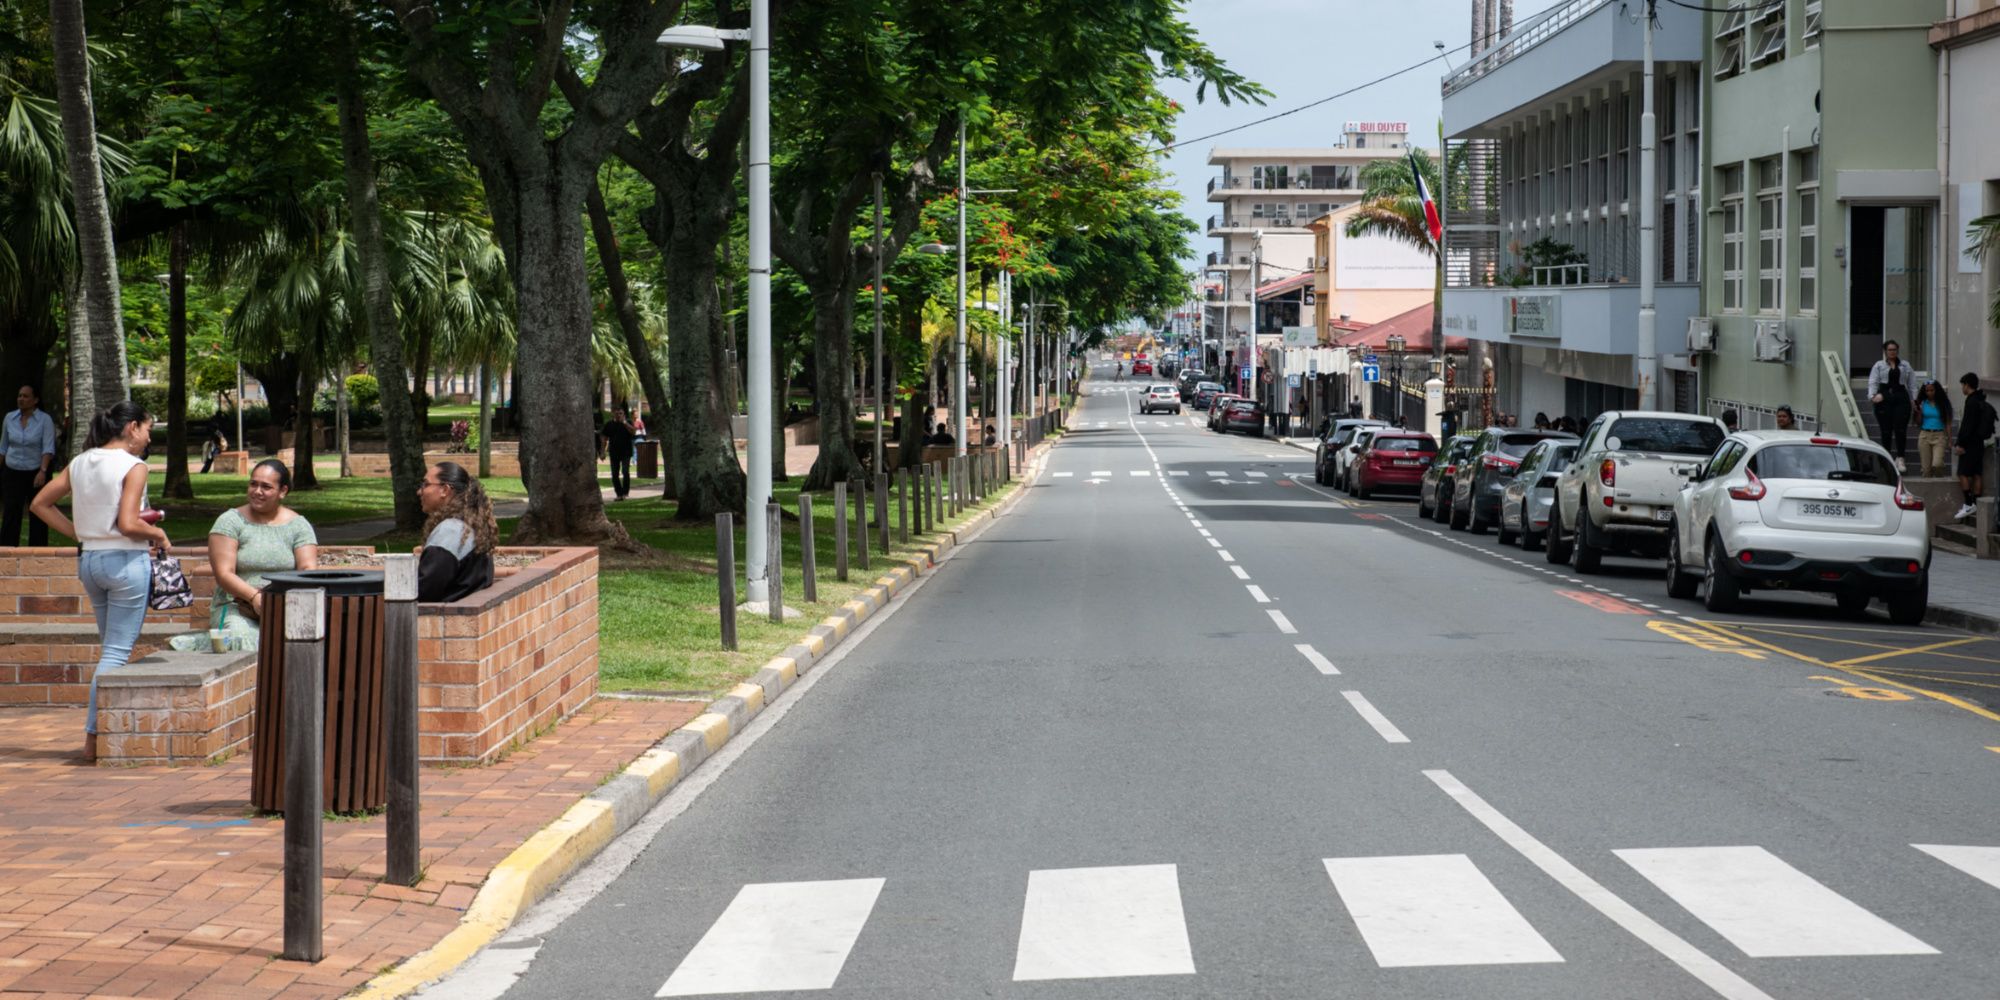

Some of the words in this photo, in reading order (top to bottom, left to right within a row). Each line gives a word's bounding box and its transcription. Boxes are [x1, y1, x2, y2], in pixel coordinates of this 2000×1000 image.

[1360, 122, 1375, 131] BUI
[1803, 504, 1821, 514] 395
[1823, 505, 1842, 516] 055
[1843, 506, 1857, 517] NC
[1660, 511, 1671, 520] 36
